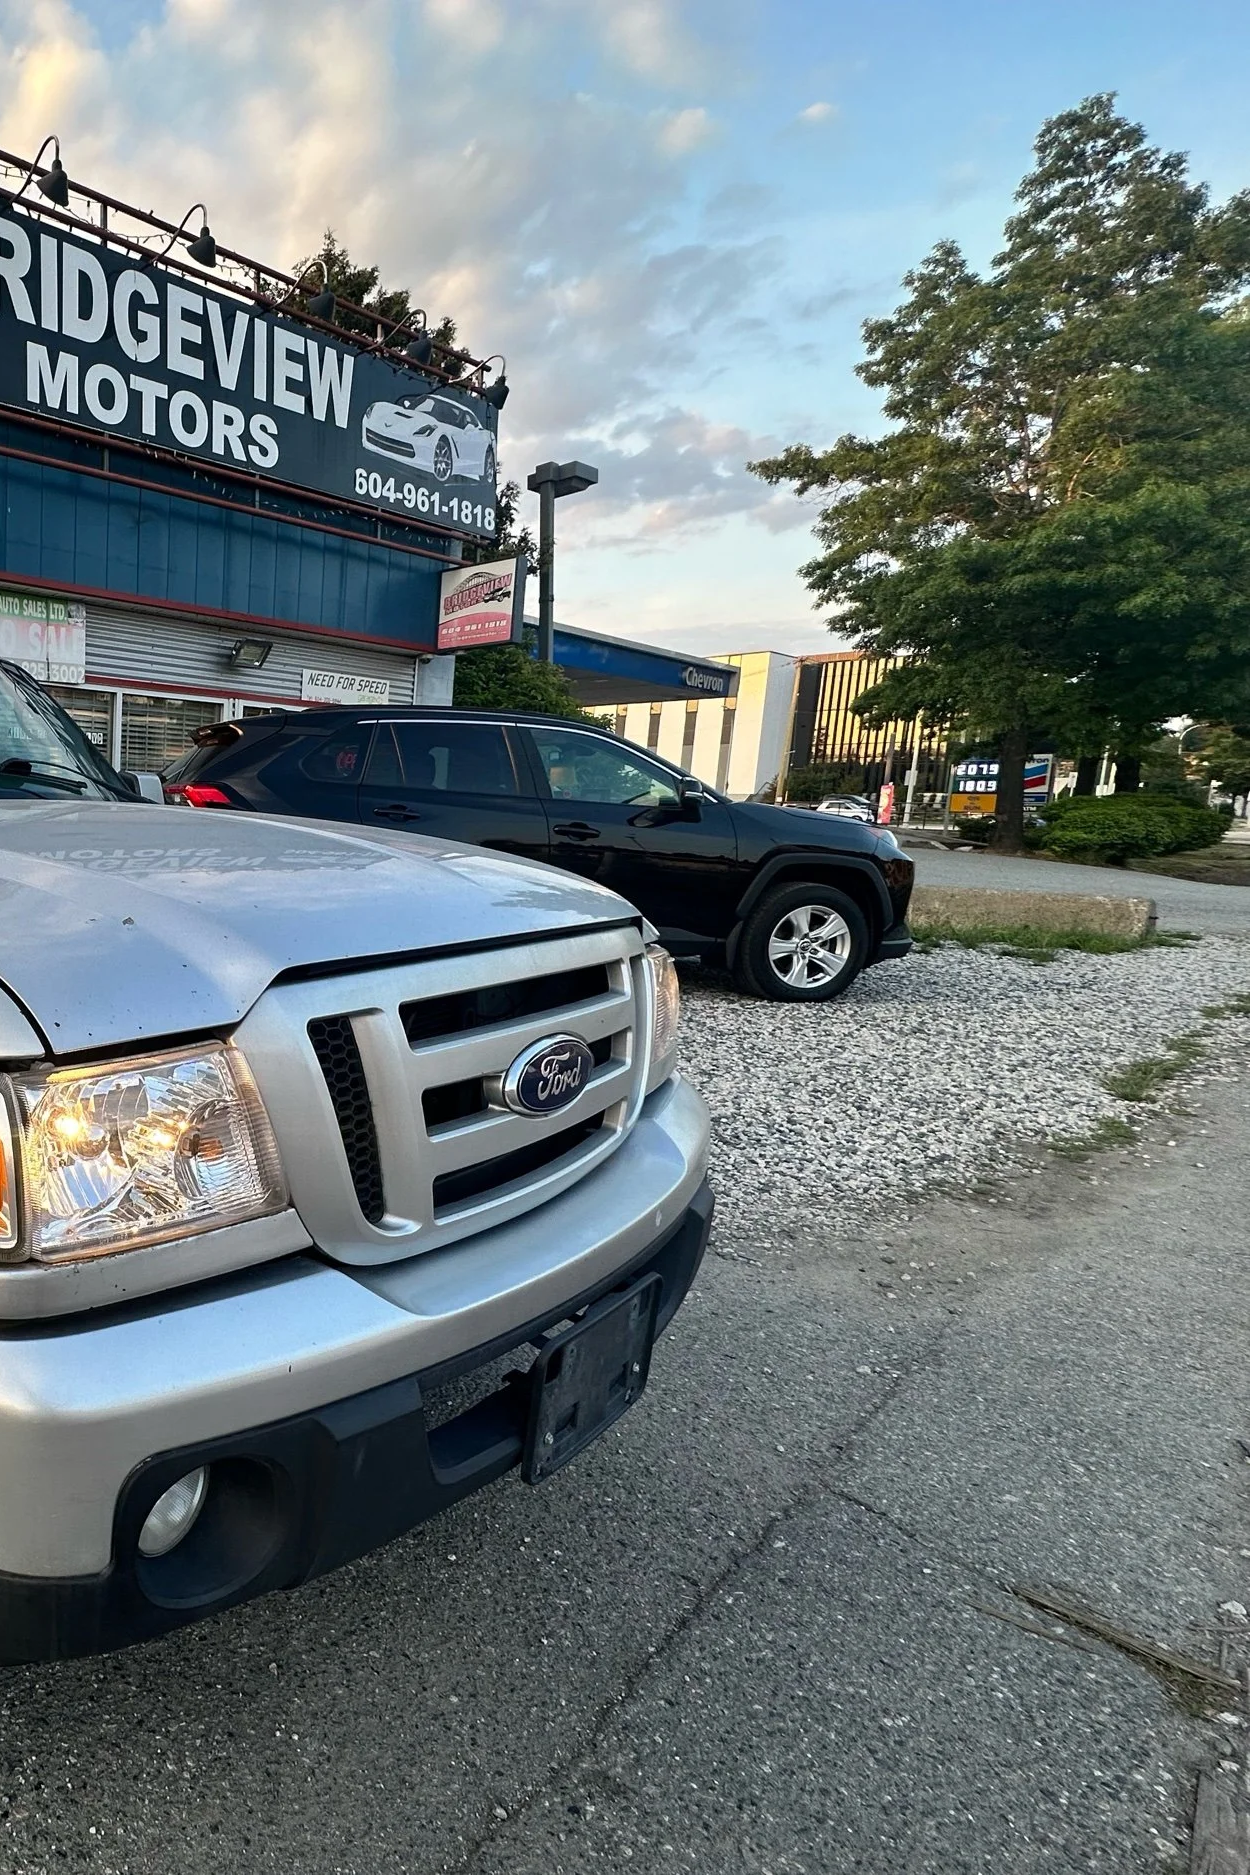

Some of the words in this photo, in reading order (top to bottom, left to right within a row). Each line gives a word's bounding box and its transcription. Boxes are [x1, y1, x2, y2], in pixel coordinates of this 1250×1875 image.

[25, 342, 280, 468] MOTORS
[354, 467, 496, 532] 604-961-1818
[23, 599, 47, 619] SALES
[50, 601, 68, 620] LTD.
[444, 573, 513, 611] BRIDGEVIEW
[307, 672, 335, 688] NEED
[335, 676, 356, 690] FOR
[356, 679, 388, 695] SPEED
[685, 666, 724, 692] Chevron
[537, 1051, 582, 1101] Ford
